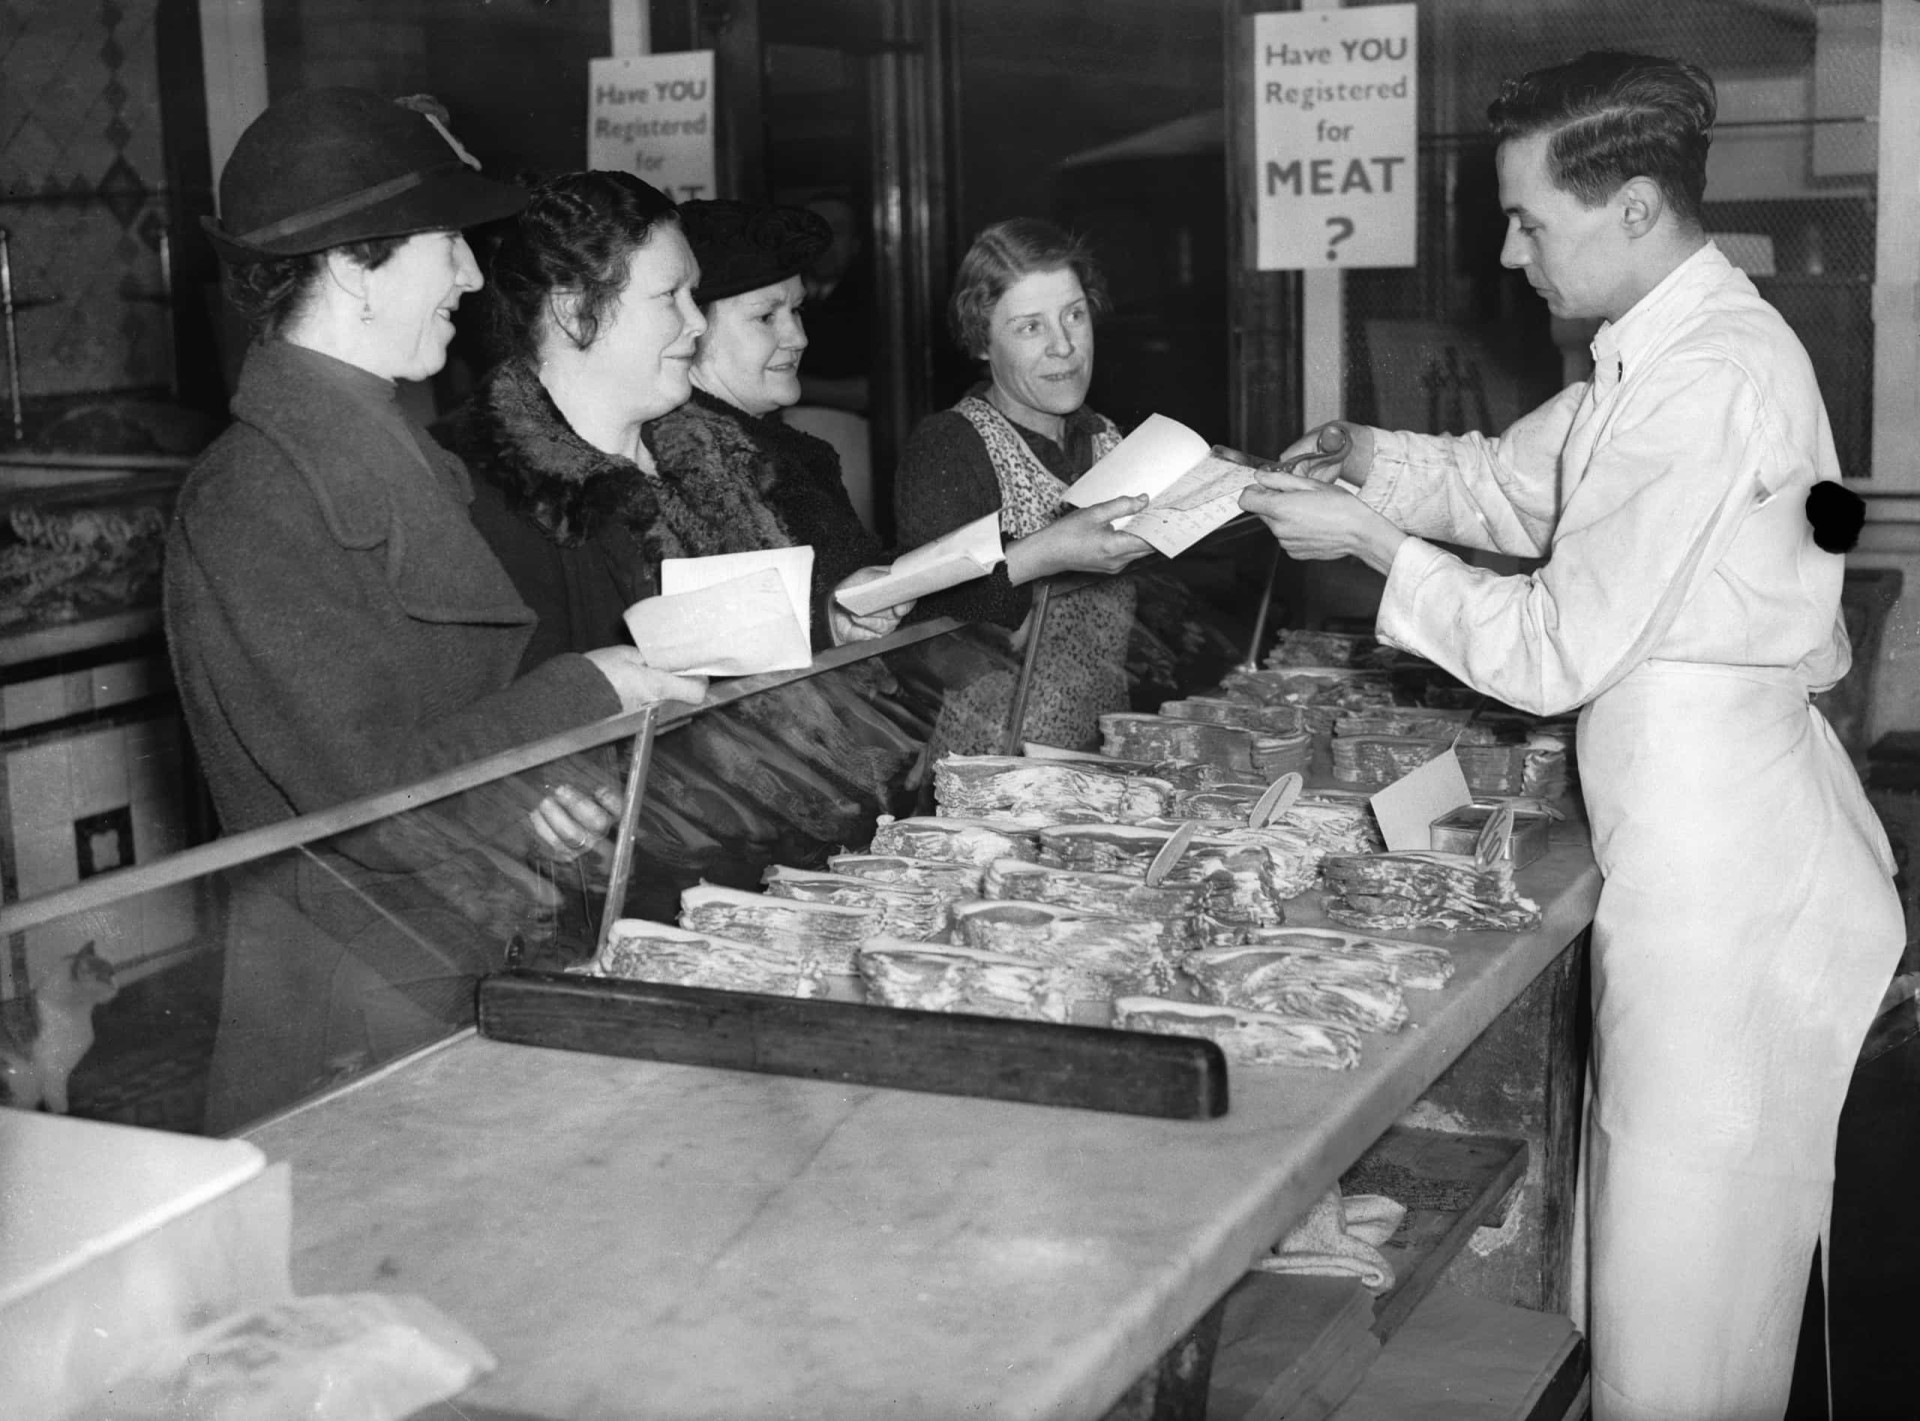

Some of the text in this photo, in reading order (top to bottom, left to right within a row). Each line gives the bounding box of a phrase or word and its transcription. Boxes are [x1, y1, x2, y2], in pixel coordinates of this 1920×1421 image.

[1265, 37, 1407, 66] Have YOU
[595, 80, 706, 106] Have YOU
[1265, 75, 1407, 110] Registered
[595, 113, 707, 144] Registered
[1316, 118, 1354, 142] for
[1265, 156, 1405, 196] MEAT
[1325, 216, 1355, 261] ?
